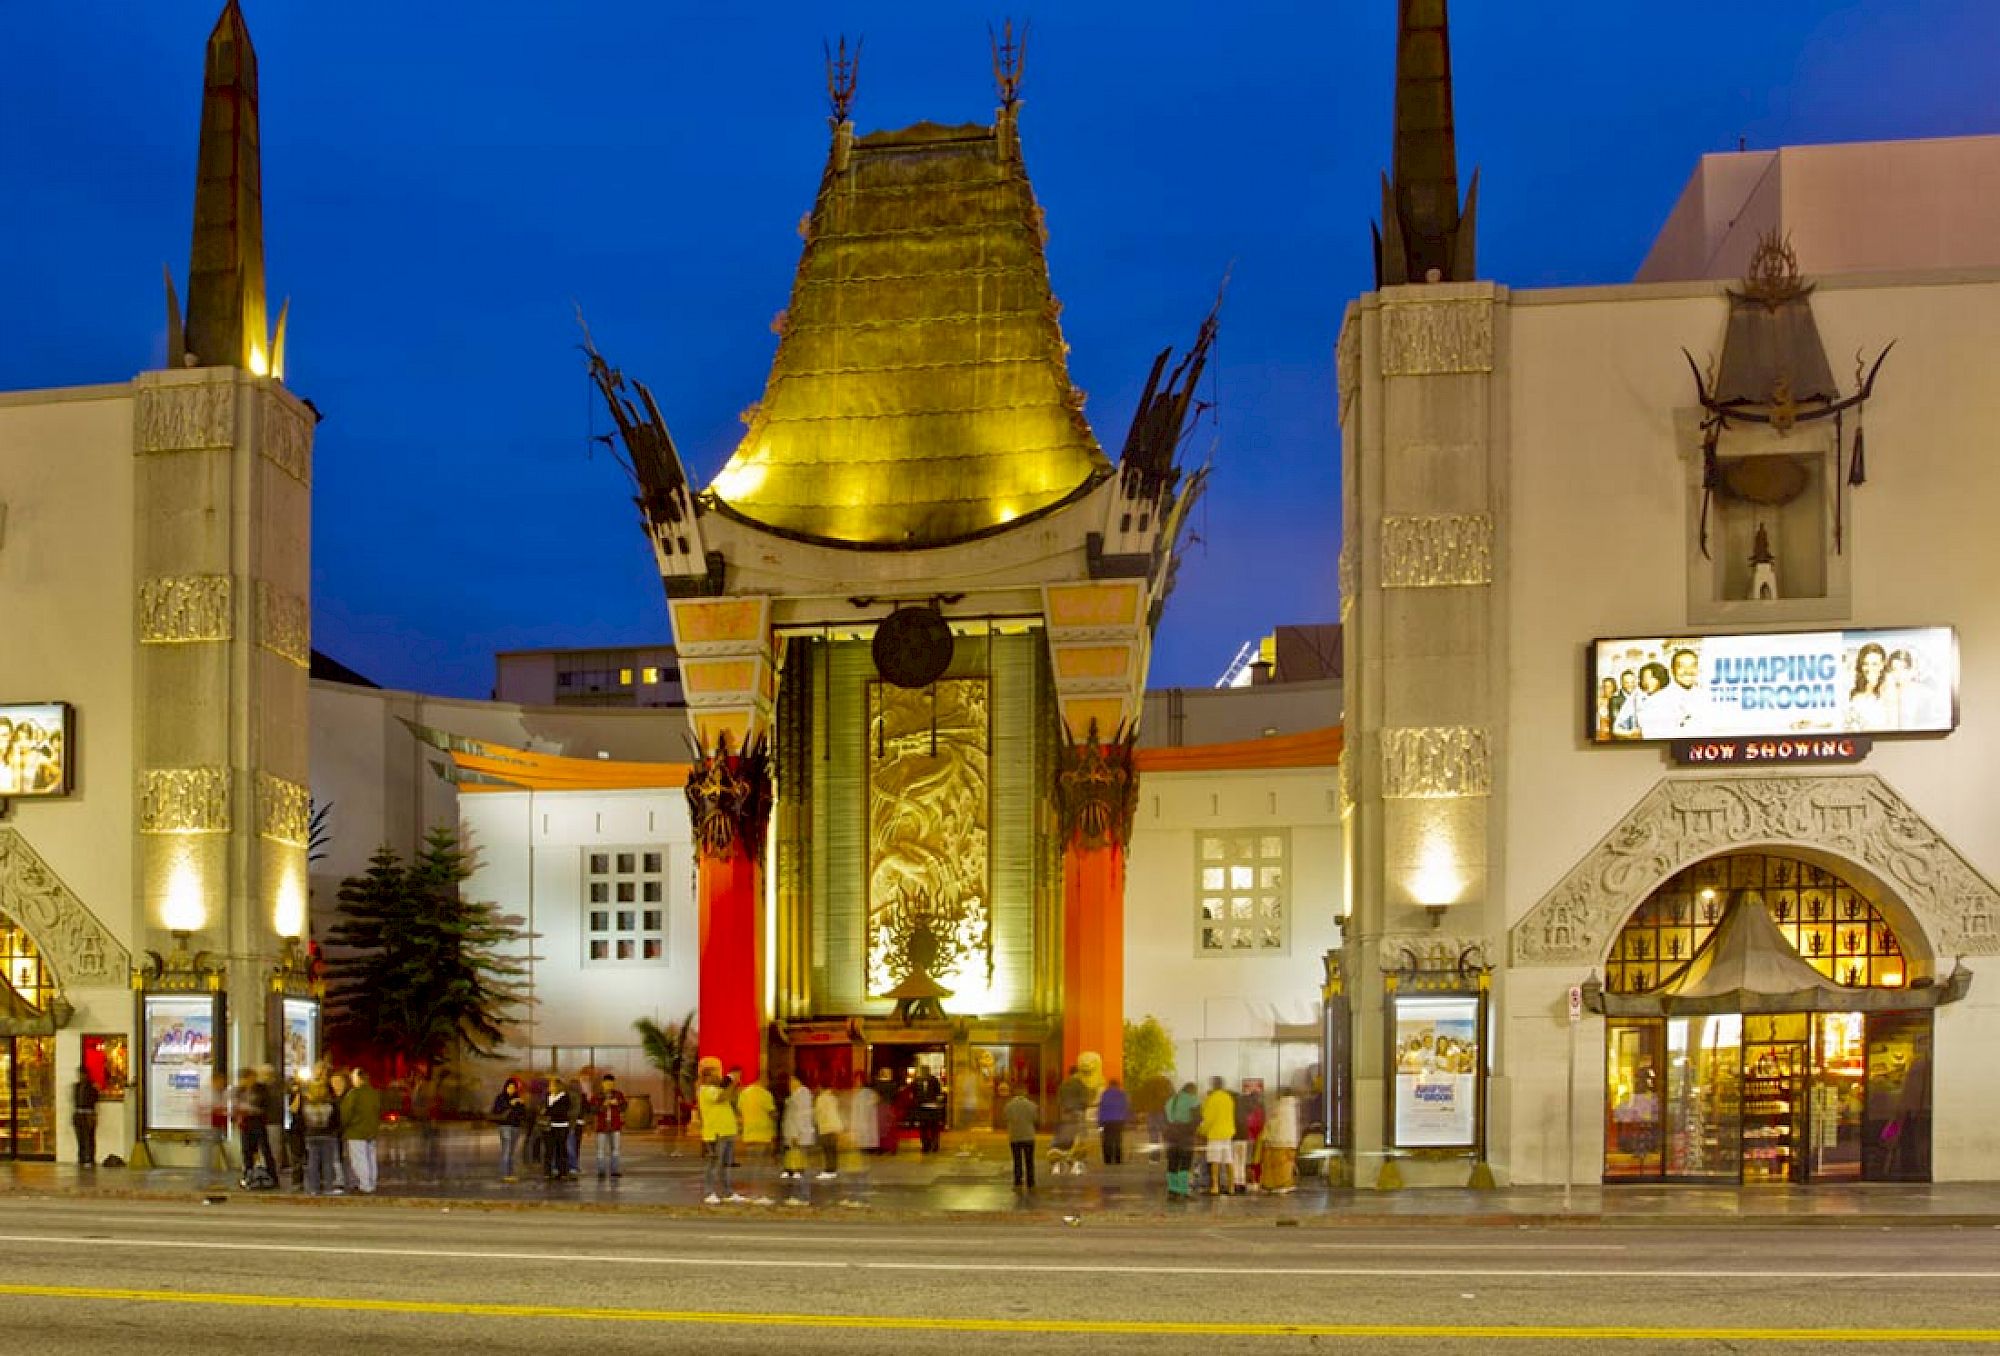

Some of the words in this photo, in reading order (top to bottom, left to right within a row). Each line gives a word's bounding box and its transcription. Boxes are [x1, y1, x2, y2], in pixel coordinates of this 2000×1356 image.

[1710, 654, 1836, 685] JUMPING
[1711, 686, 1738, 703] THE
[1741, 684, 1836, 710] BROOM
[1690, 743, 1736, 761] NOW
[1745, 741, 1855, 760] SHOWING
